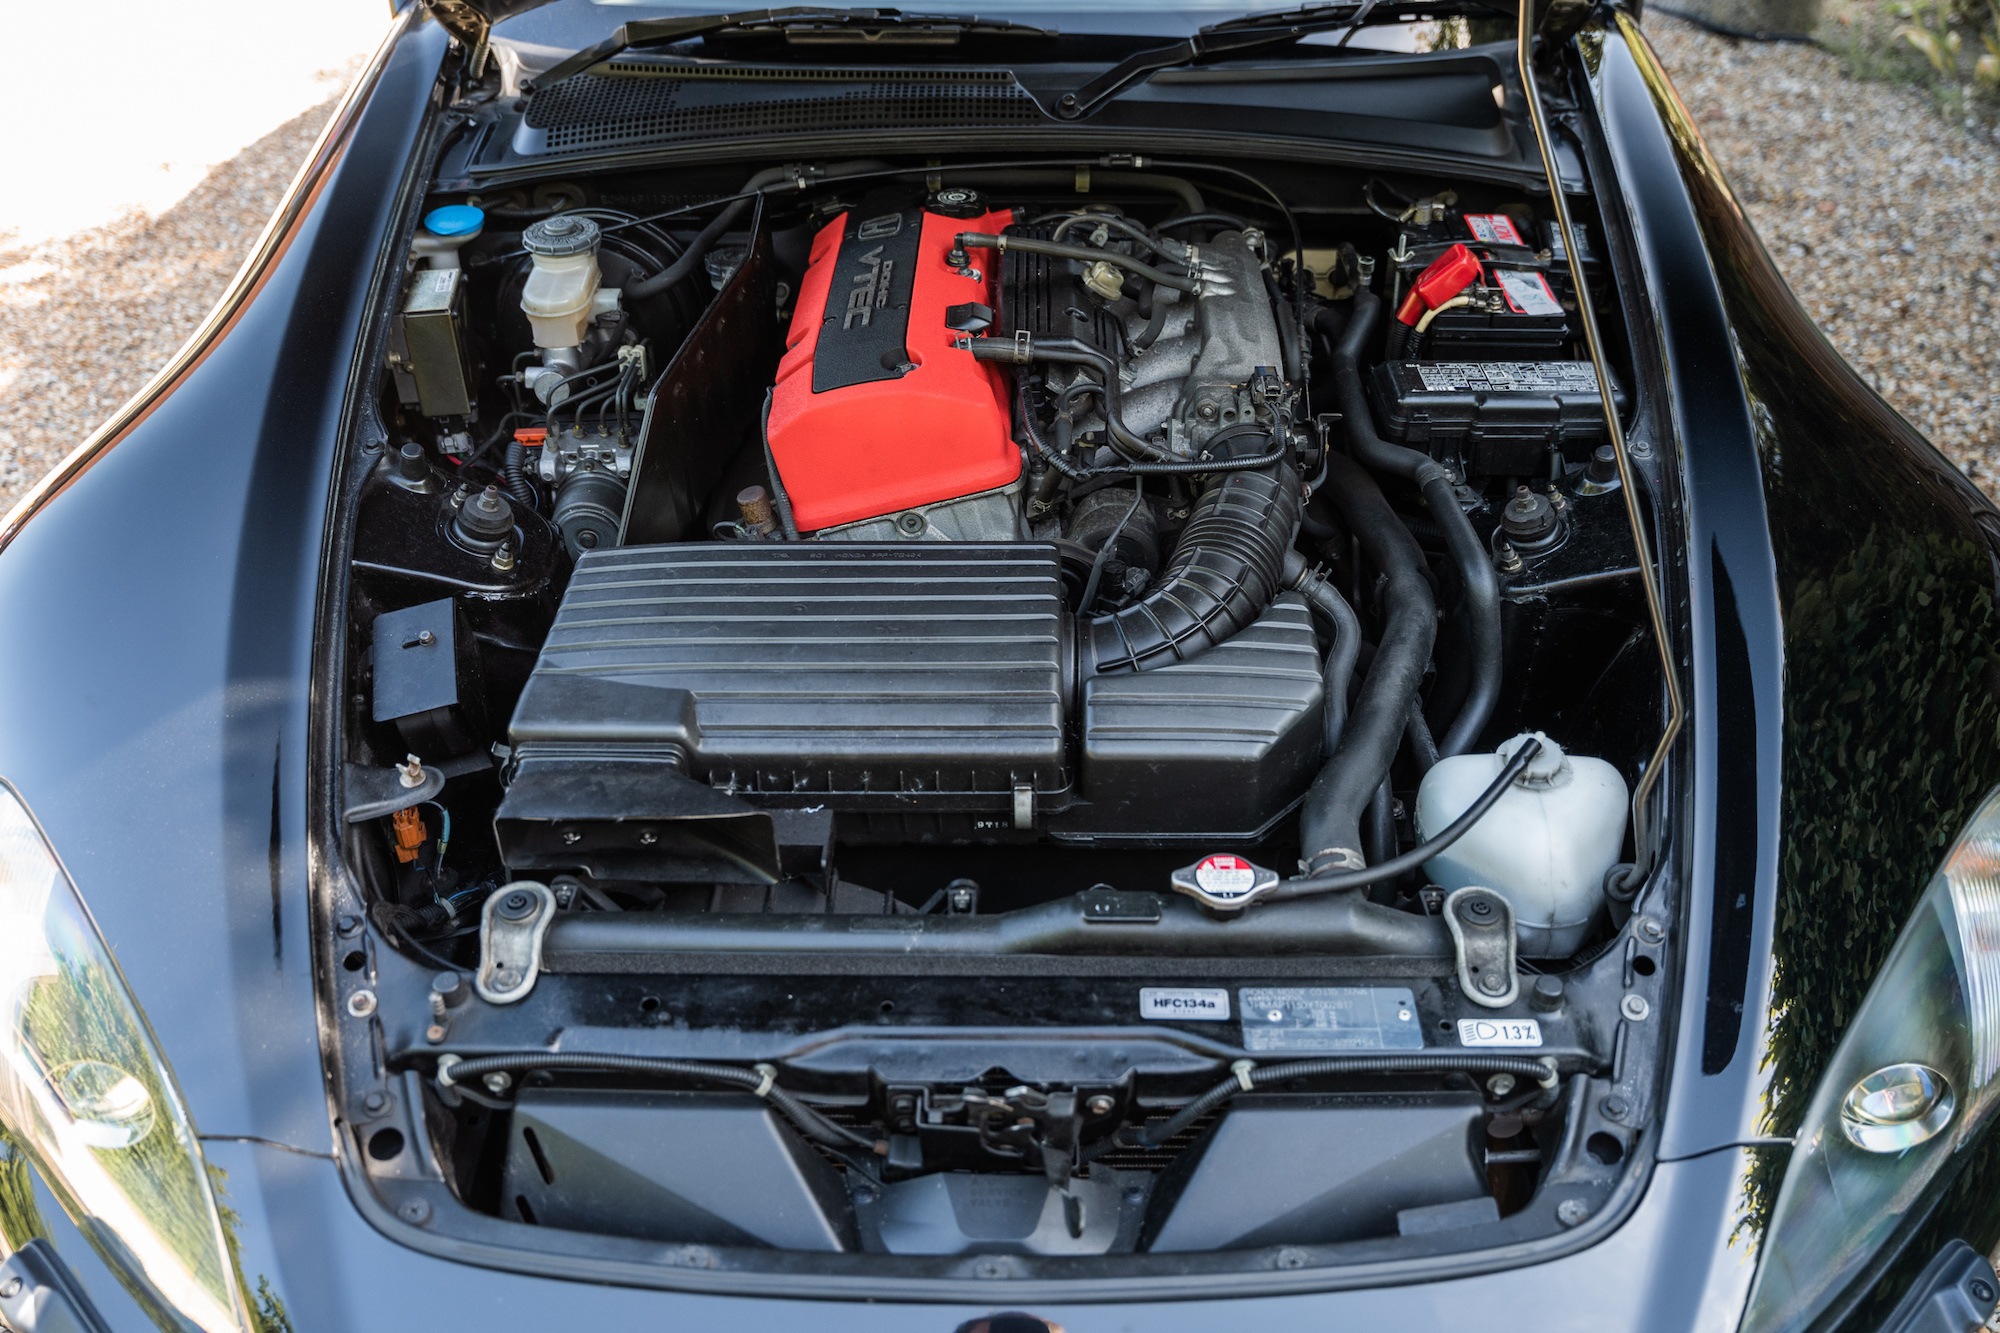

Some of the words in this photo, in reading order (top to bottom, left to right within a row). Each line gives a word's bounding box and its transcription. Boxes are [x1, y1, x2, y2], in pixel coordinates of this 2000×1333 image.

[843, 245, 884, 332] VTEC
[876, 260, 894, 309] DOHC
[1278, 988, 1305, 996] MOTOR
[1153, 998, 1216, 1009] HFC134a
[1502, 1025, 1536, 1041] 1.3%
